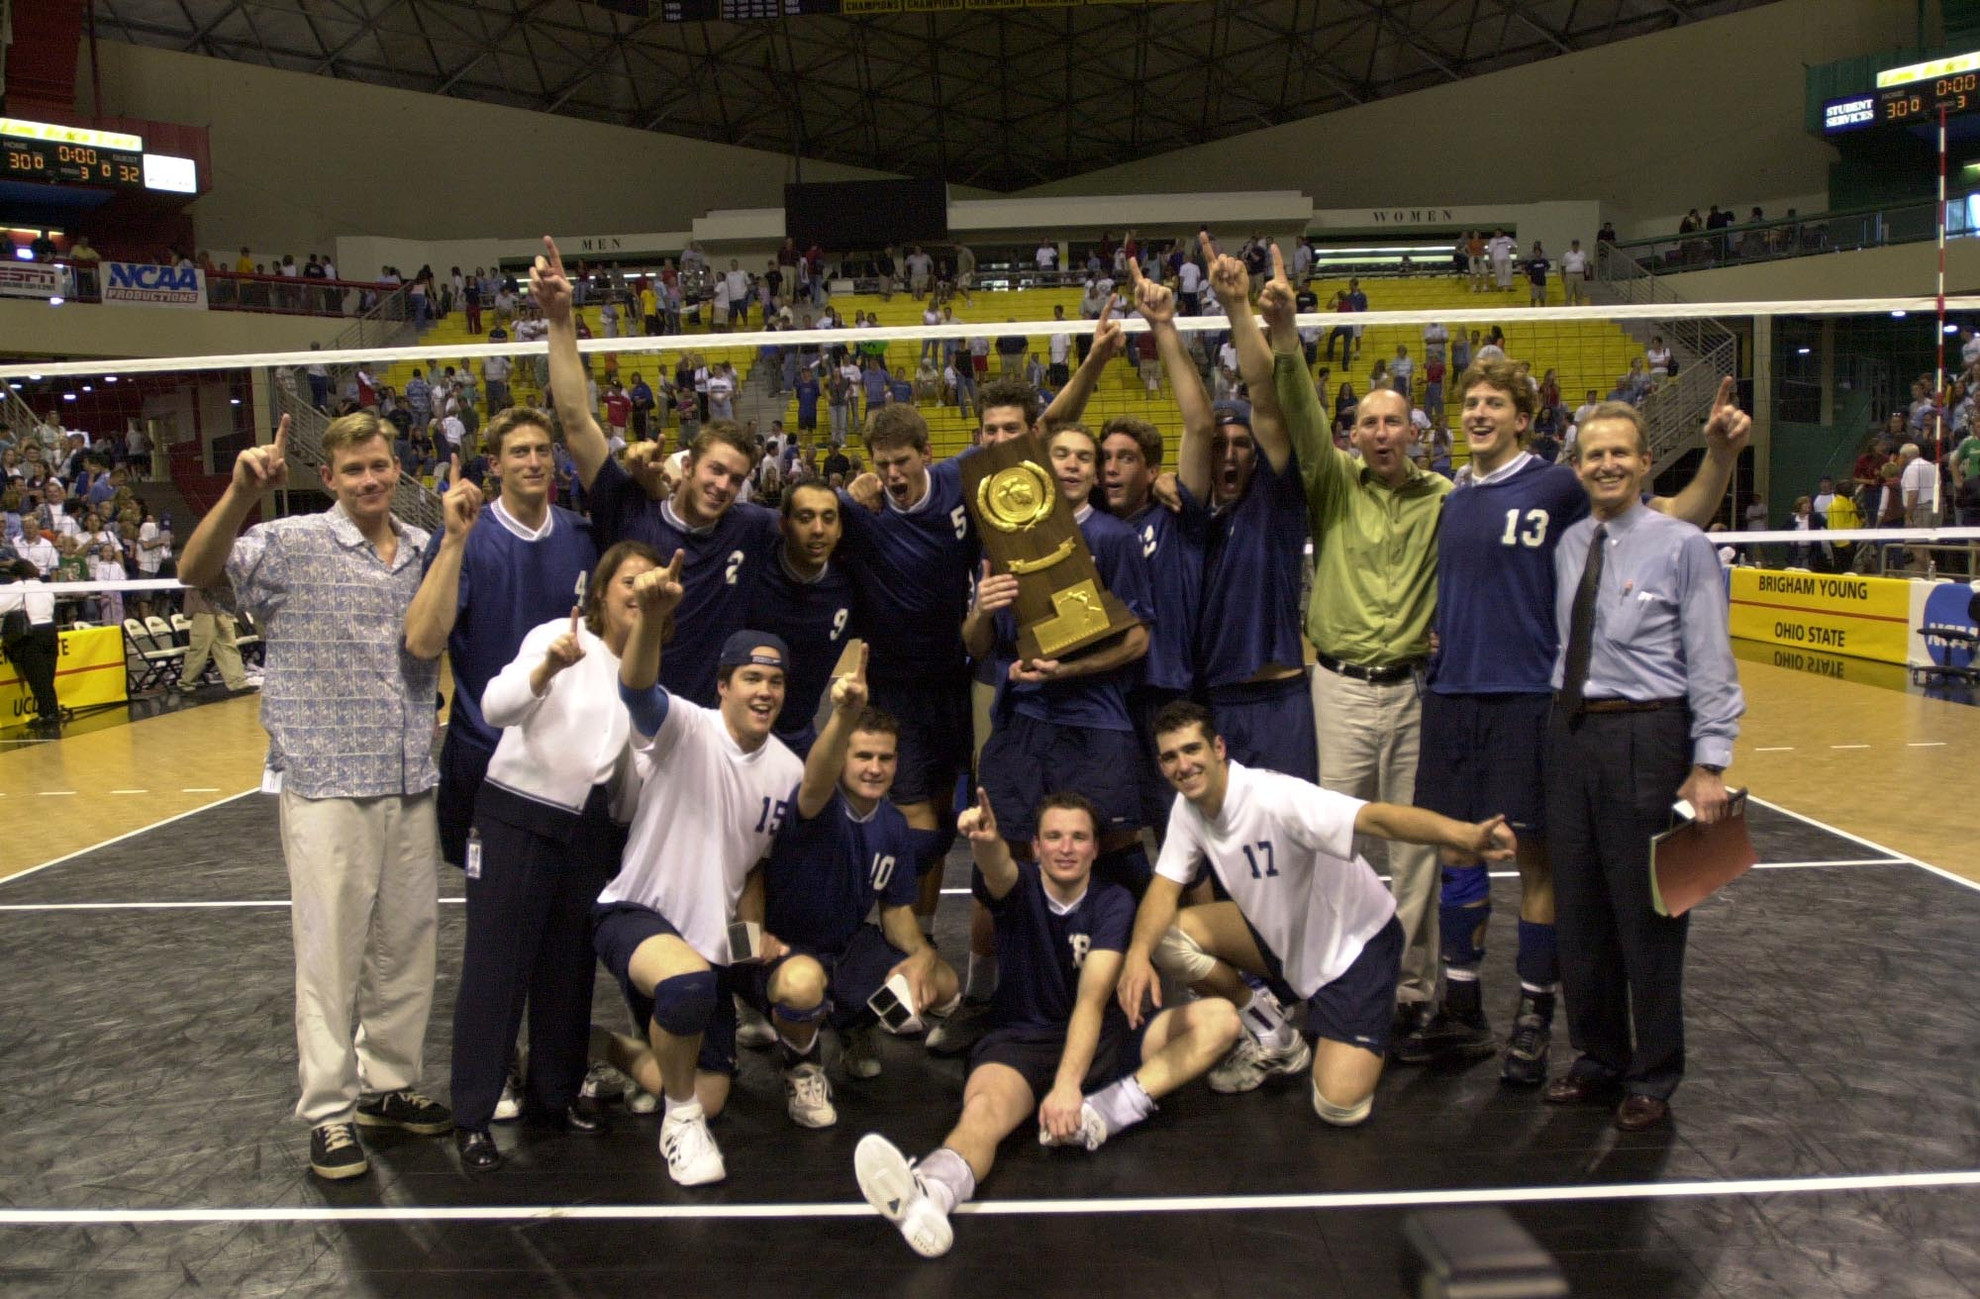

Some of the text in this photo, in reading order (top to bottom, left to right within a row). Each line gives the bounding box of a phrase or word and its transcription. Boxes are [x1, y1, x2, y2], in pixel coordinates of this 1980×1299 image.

[1936, 74, 1976, 96] 0:00
[1826, 99, 1874, 117] STUDENT
[1887, 101, 1907, 119] 30
[1957, 95, 1966, 108] 3
[1826, 110, 1874, 128] SERVICES
[10, 152, 31, 170] 30
[58, 146, 97, 165] 0:00
[80, 166, 89, 180] 3
[119, 165, 139, 183] 32
[1373, 209, 1453, 222] WOMEN
[582, 237, 621, 250] MEN
[108, 263, 199, 291] NCAA
[108, 287, 198, 303] PRODUCTIONS
[951, 504, 967, 540] 5
[1501, 508, 1550, 548] 13
[725, 550, 745, 584] 2
[573, 569, 588, 607] 4
[1758, 575, 1868, 600] BRIGHAM YOUNG
[829, 608, 849, 641] 9
[1774, 621, 1846, 648] OHIO STATE
[13, 696, 40, 718] UCL
[754, 796, 788, 836] 15
[1242, 840, 1279, 880] 17
[868, 852, 896, 891] 10
